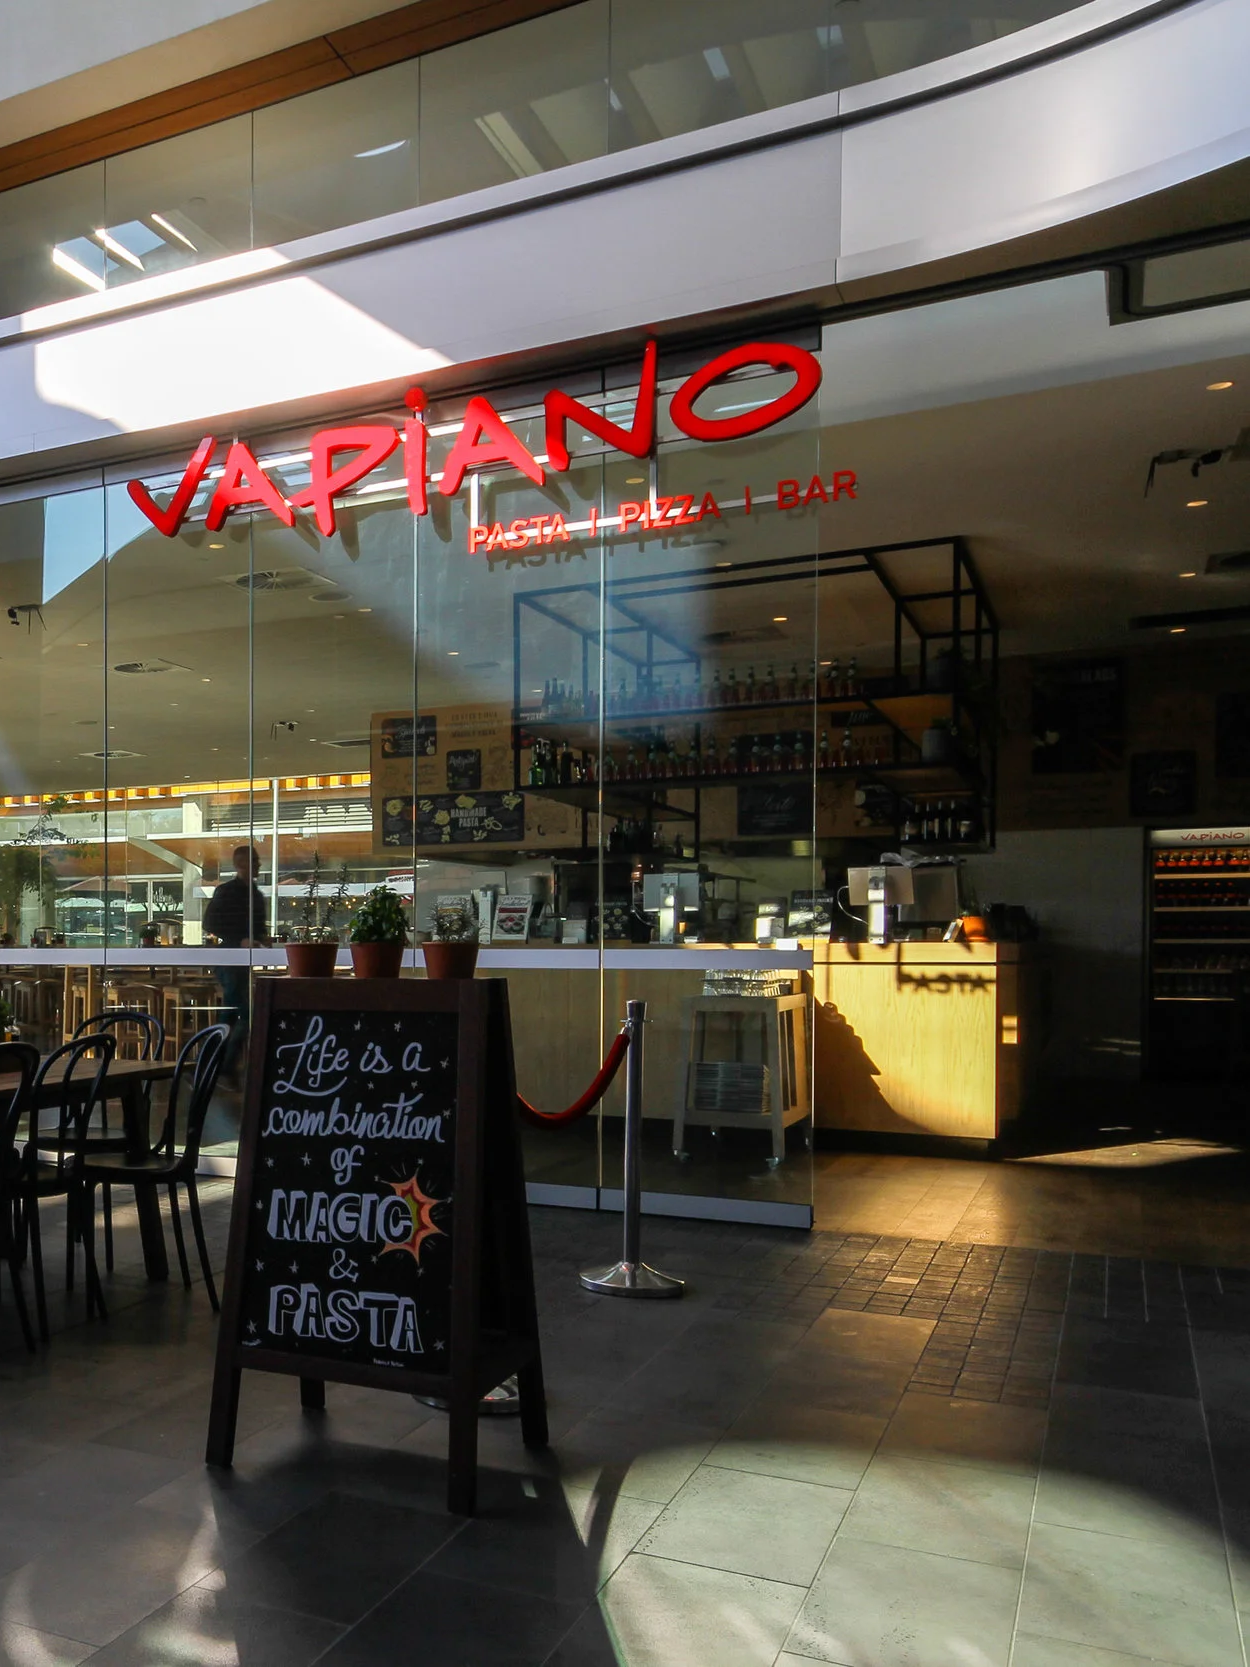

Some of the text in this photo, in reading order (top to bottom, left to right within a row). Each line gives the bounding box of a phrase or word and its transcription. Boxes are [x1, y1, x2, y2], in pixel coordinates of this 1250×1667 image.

[469, 513, 571, 554] PASTA
[620, 491, 721, 532] PIZZA
[776, 469, 858, 510] BAR
[450, 806, 487, 818] HANDMADE
[458, 817, 479, 828] PASTA
[273, 1015, 431, 1097] Life is a
[261, 1093, 446, 1142] combination
[330, 1145, 365, 1185] of
[267, 1188, 415, 1244] MAGIC
[329, 1248, 360, 1282] &
[268, 1284, 425, 1354] PASTA
